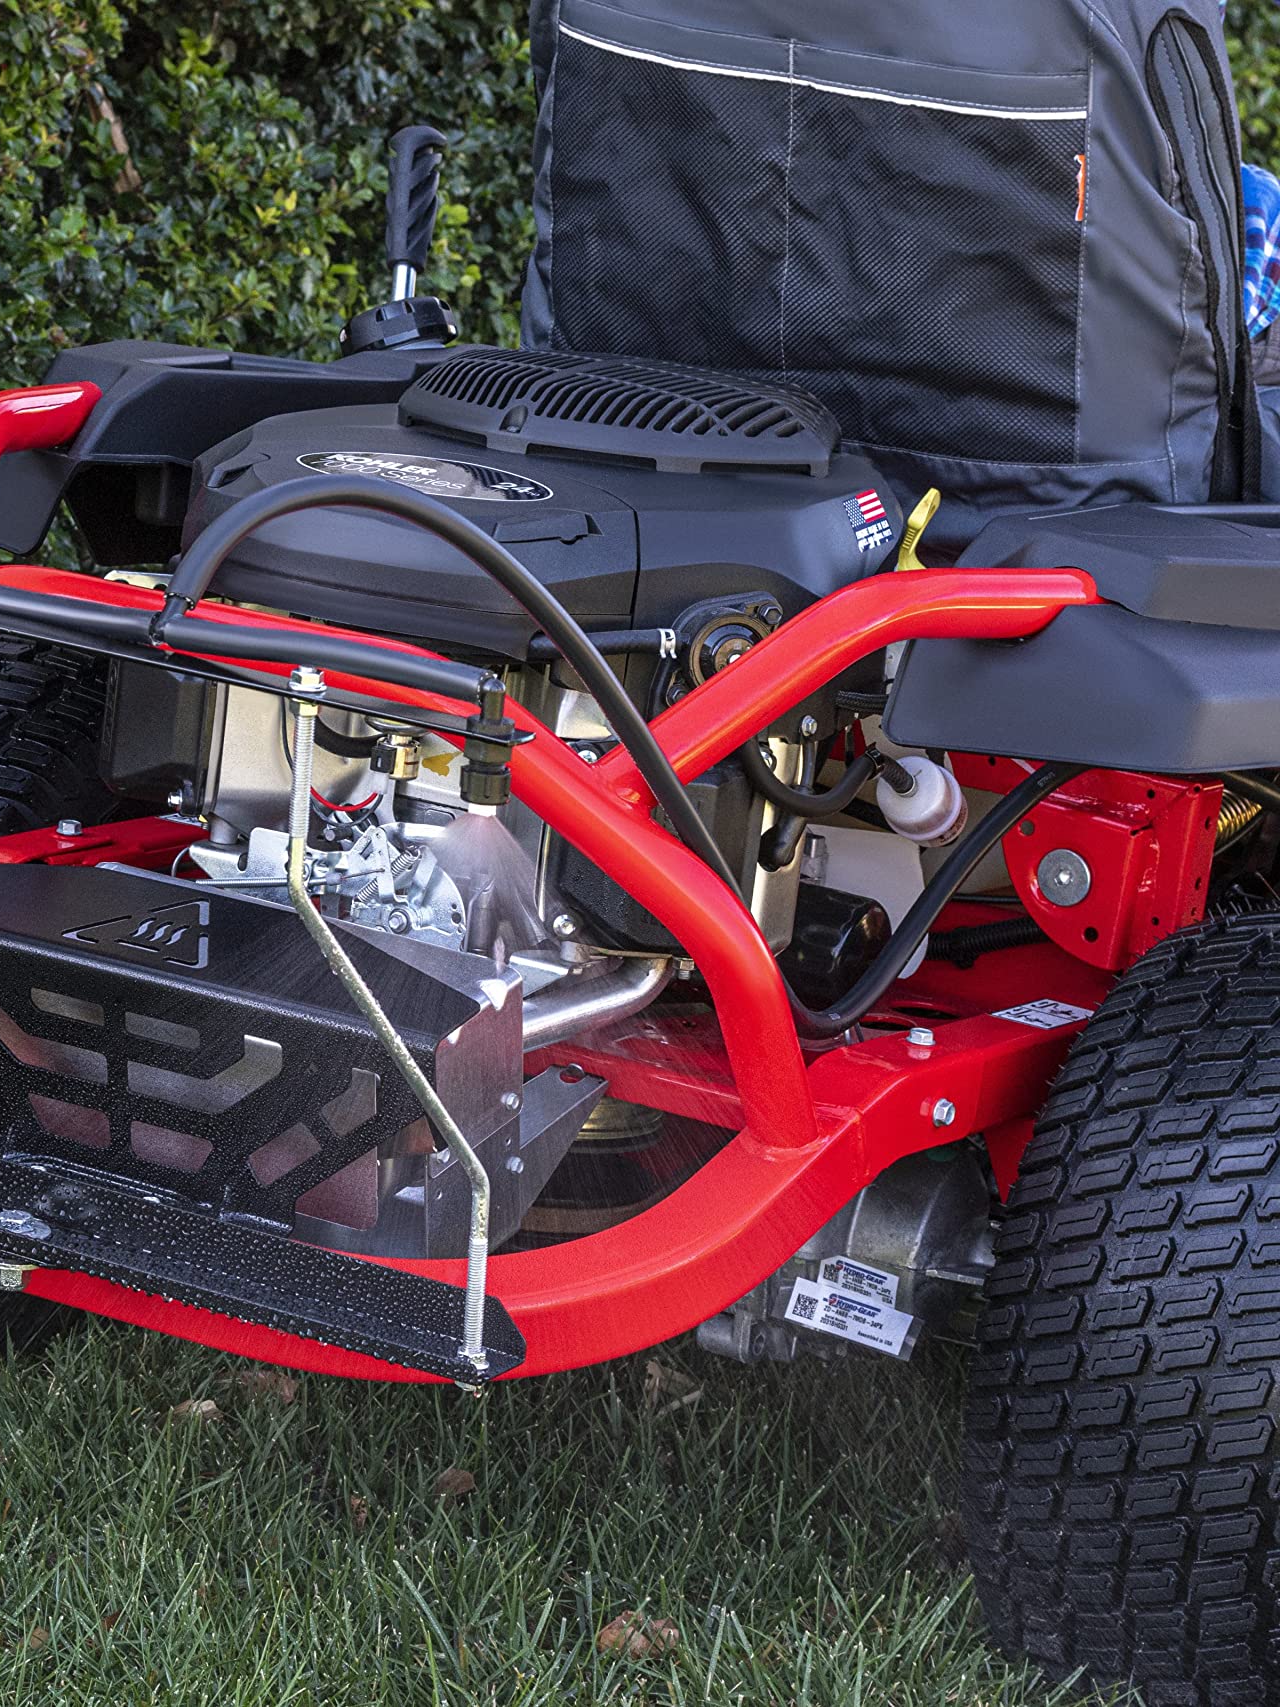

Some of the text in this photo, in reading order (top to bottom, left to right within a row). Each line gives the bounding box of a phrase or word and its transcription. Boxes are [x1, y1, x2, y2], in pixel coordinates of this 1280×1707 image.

[311, 458, 382, 474] 7000
[380, 471, 466, 490] Series
[326, 453, 437, 476] KOHLER
[490, 482, 534, 494] 24
[837, 1300, 877, 1318] HYDRO-GEAR
